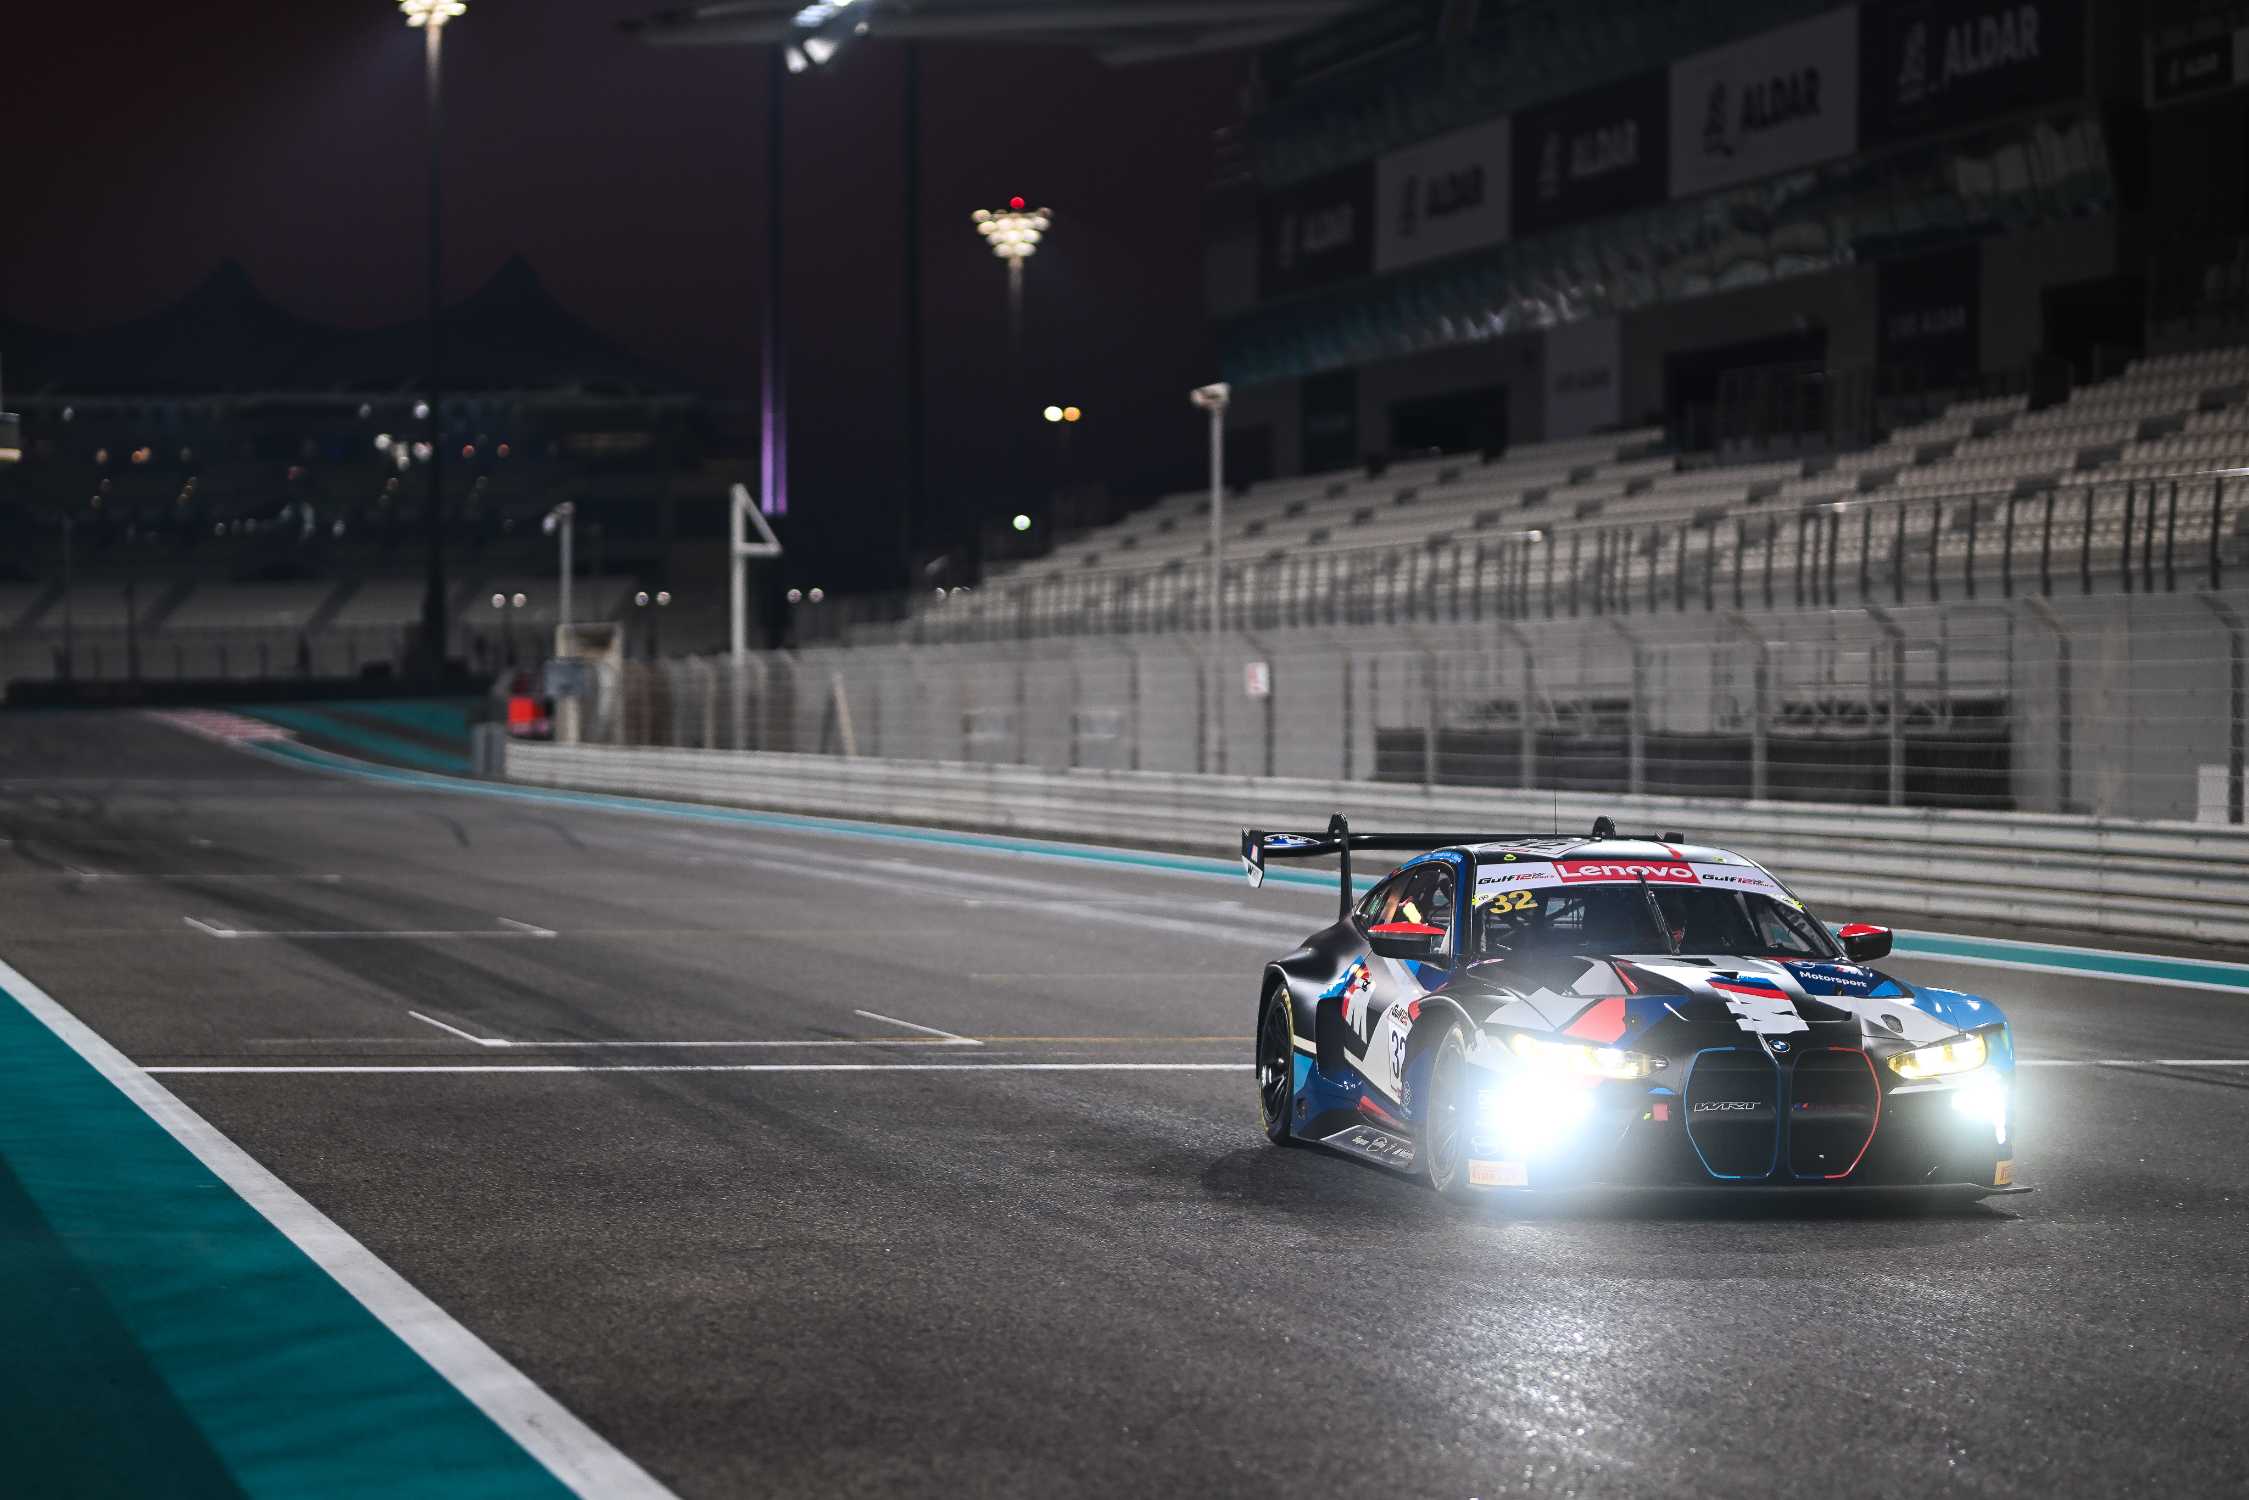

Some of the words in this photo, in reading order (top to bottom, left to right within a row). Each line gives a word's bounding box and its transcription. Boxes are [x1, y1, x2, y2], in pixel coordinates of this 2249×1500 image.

[1942, 4, 2040, 82] ALDAR
[1739, 69, 1821, 132] ALDAR
[1567, 118, 1640, 182] ALDAR
[1556, 864, 1694, 879] Lenovo
[1488, 890, 1538, 914] 32
[1799, 971, 1868, 988] Motorsport
